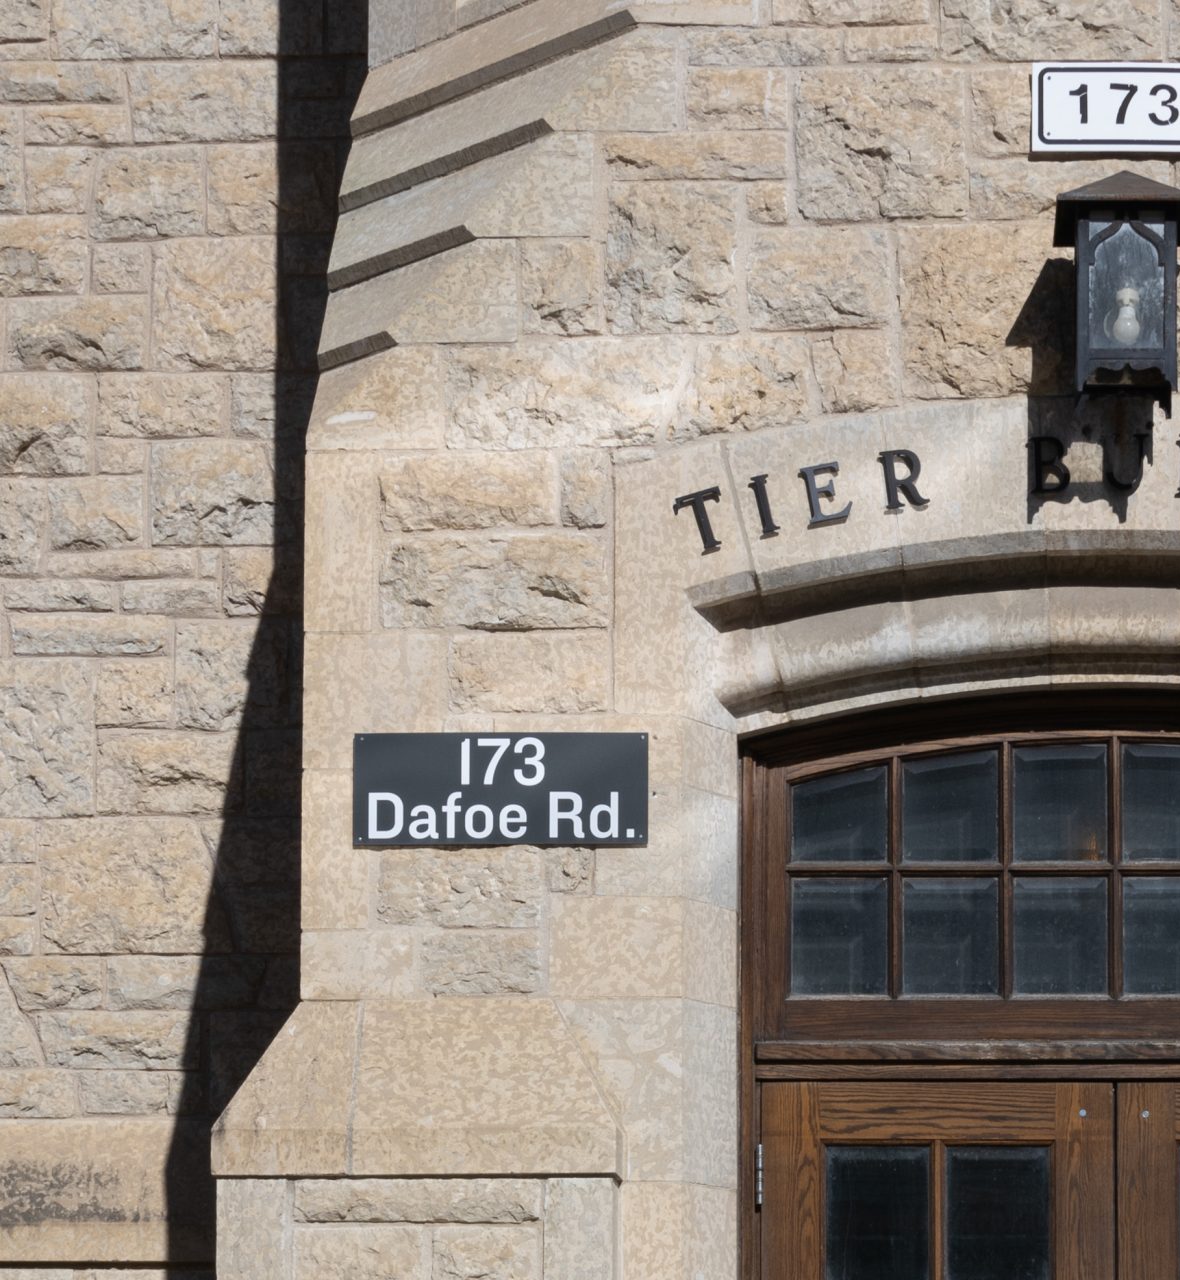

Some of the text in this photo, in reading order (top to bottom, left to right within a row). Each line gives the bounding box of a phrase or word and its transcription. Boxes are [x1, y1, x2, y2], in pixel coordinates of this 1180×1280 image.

[1069, 83, 1179, 126] 173
[674, 448, 931, 552] TIER
[461, 737, 546, 786] 173
[368, 791, 635, 839] Dafoe Rd.
